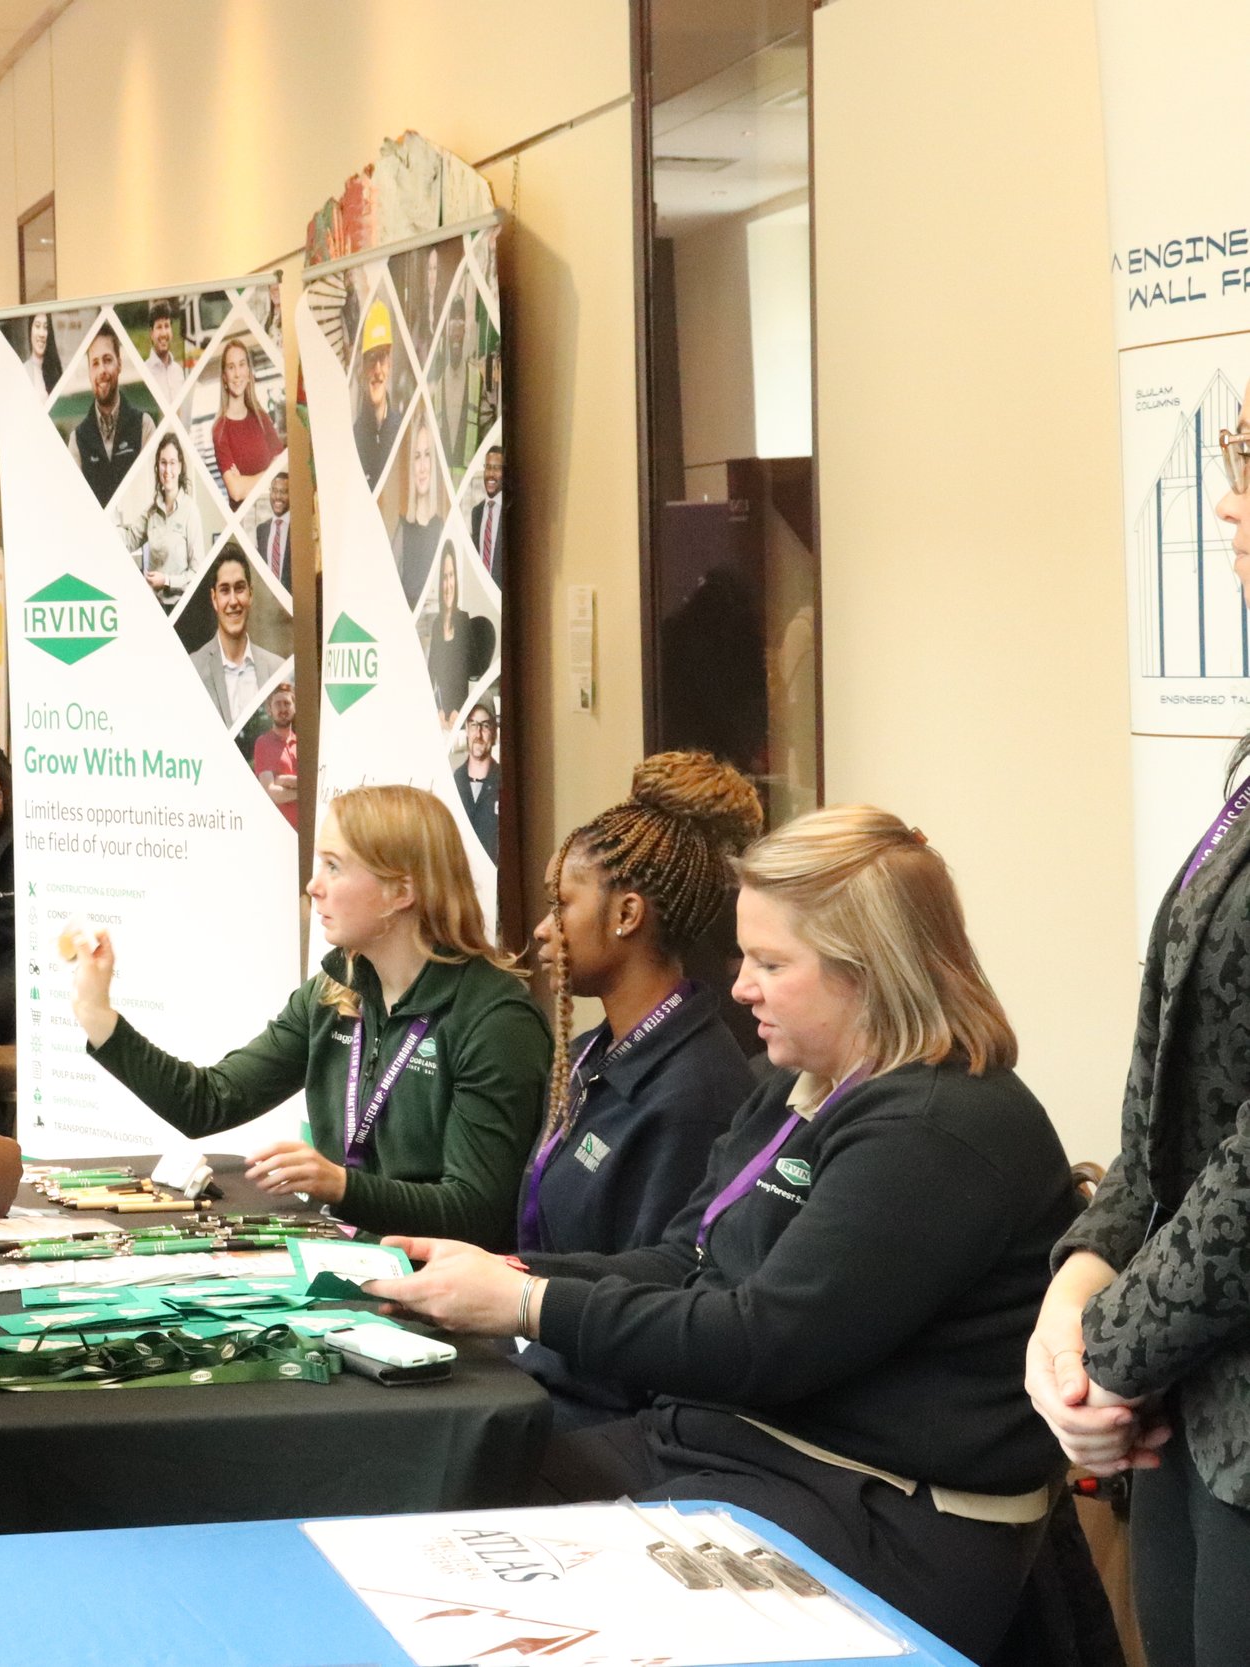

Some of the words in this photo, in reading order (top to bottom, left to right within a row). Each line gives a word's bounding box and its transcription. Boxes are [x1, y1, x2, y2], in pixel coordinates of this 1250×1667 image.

[1128, 228, 1249, 275] ENGINE
[1128, 275, 1207, 312] WALL
[1135, 397, 1181, 412] COLUMNS
[23, 605, 119, 633] IRVING
[324, 647, 379, 678] IRVING
[1159, 694, 1226, 705] ENGINEERED
[23, 701, 61, 731] Join
[65, 701, 115, 735] One,
[23, 745, 79, 775] Grow
[82, 747, 137, 778] With
[142, 749, 204, 786] Many
[24, 799, 84, 823] Limitless
[86, 805, 185, 828] opportunities
[187, 808, 227, 831] await
[229, 809, 244, 831] in
[24, 830, 46, 851] the
[48, 831, 80, 853] field
[83, 833, 98, 855] of
[100, 840, 133, 859] your
[135, 837, 189, 861] choice!
[46, 883, 100, 897] CONSTRUCTION
[105, 887, 147, 900] EQUIPMENT
[48, 989, 72, 1001] FORES
[661, 992, 684, 1014] GIRLS
[641, 1009, 665, 1033] STEM
[351, 1045, 360, 1067] STEM
[380, 1032, 419, 1091] BREAKTHROUGH
[51, 1068, 70, 1081] PULP
[75, 1071, 97, 1084] PAPER
[375, 1089, 387, 1104] UP:
[364, 1101, 380, 1124] STEM
[53, 1121, 113, 1141] TRANSPORTATION
[119, 1130, 155, 1147] LOGISTICS
[354, 1122, 371, 1145] GIRLS
[780, 1162, 810, 1180] IRVIN
[770, 1184, 796, 1201] Forest
[451, 1528, 560, 1583] ATLAS
